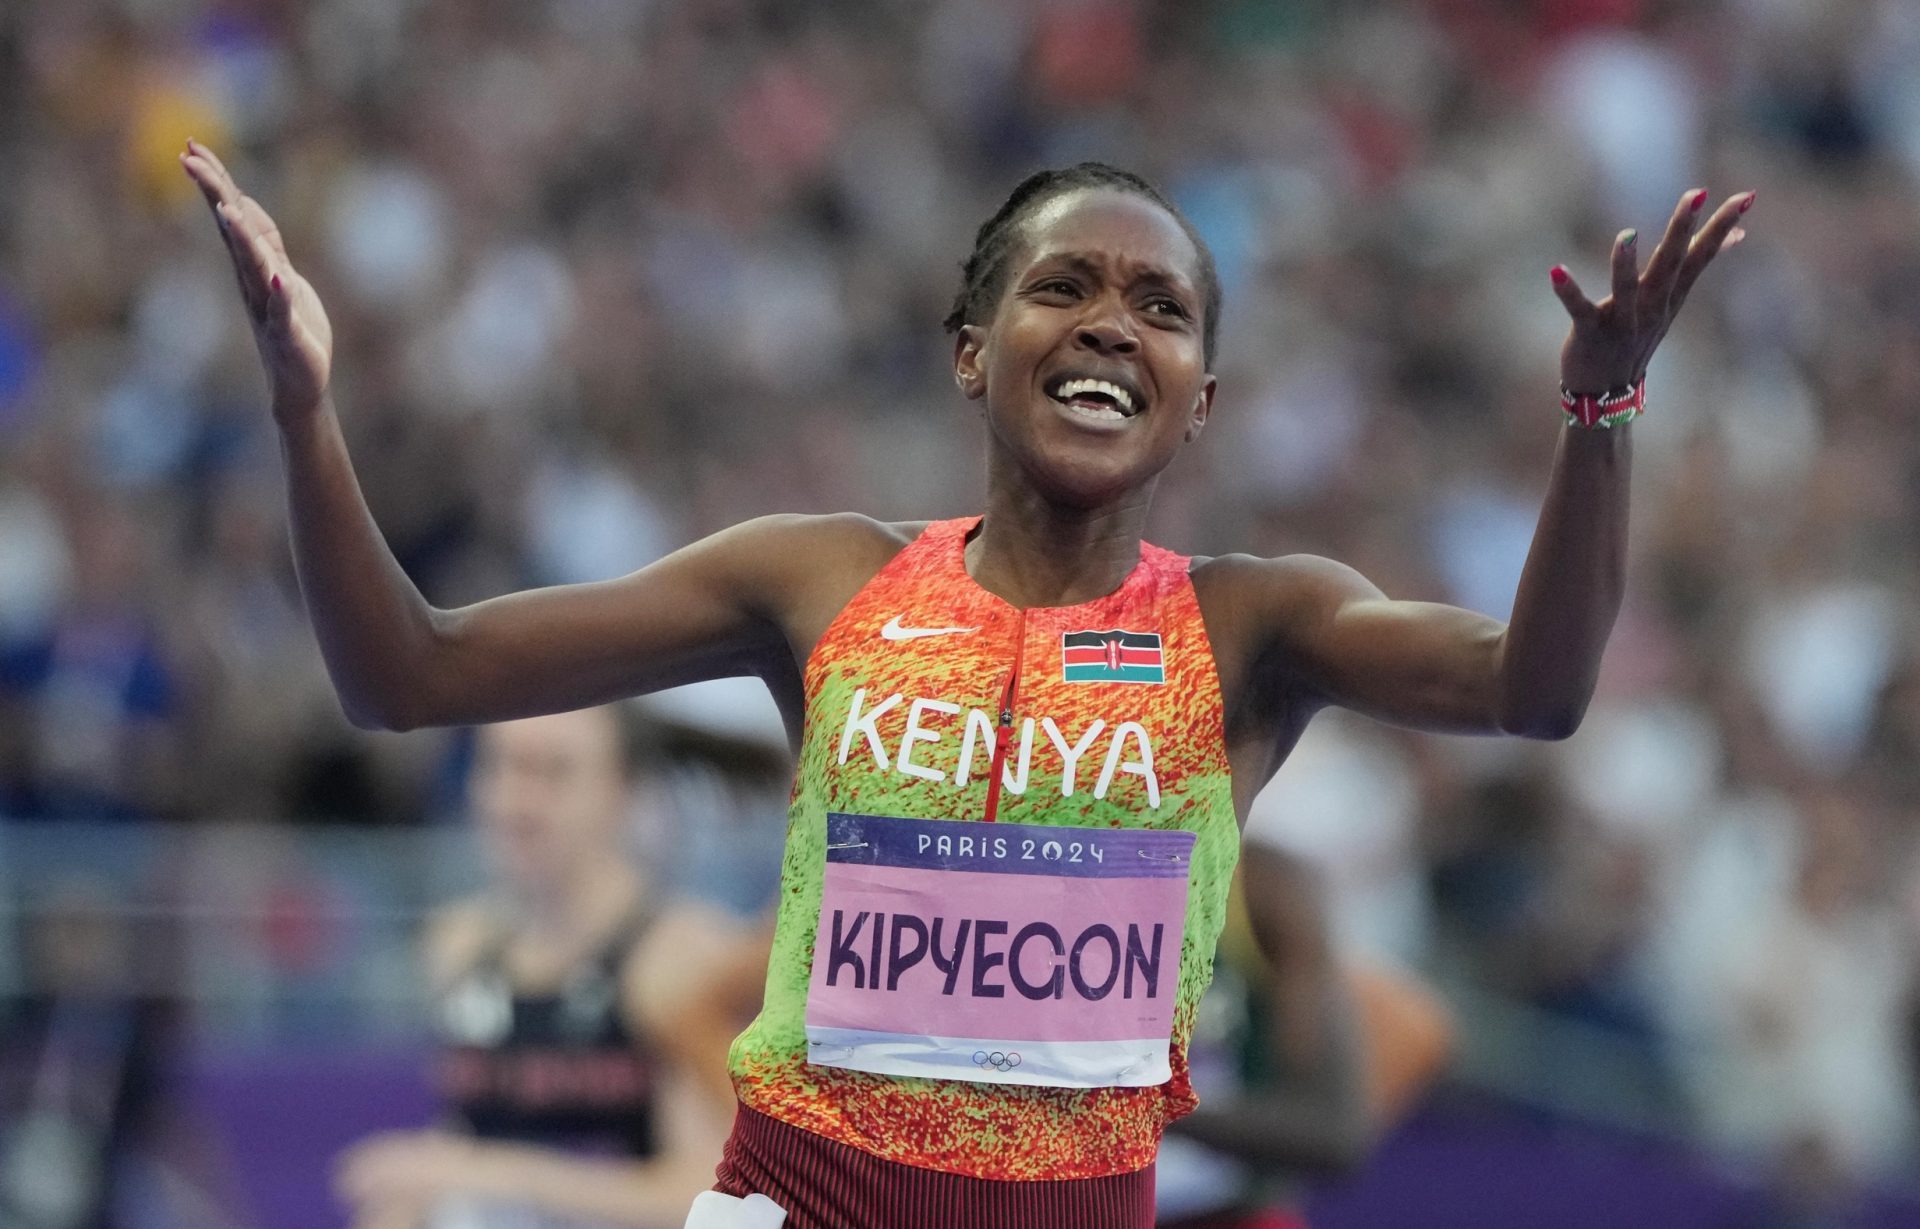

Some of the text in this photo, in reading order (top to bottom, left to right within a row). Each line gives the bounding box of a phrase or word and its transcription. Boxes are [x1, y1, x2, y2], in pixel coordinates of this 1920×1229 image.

[838, 688, 1160, 808] KENYA
[1021, 839, 1103, 864] 2024
[826, 910, 1164, 1000] KIPYEGON
